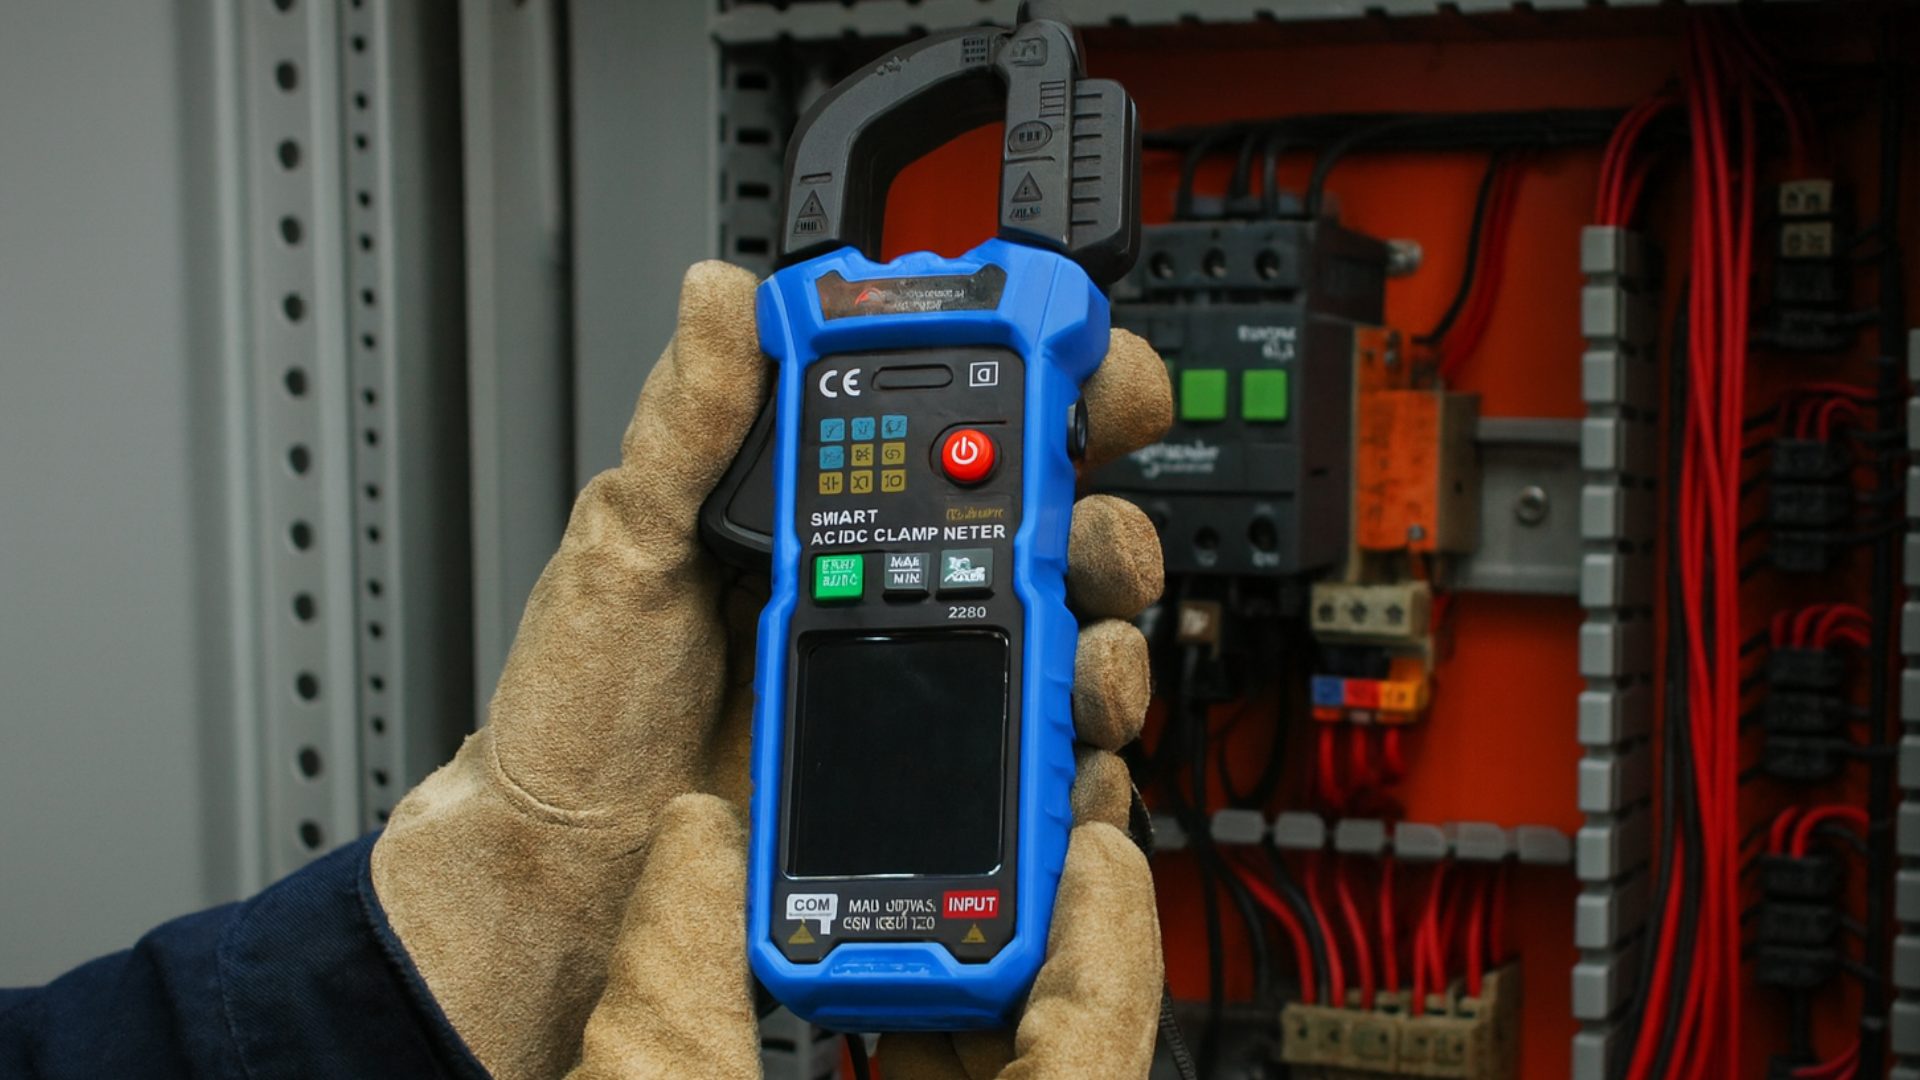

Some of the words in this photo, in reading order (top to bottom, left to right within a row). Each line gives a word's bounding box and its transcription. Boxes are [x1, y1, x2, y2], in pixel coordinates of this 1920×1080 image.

[819, 368, 862, 398] CE
[874, 527, 939, 542] CLAMP
[943, 524, 1006, 541] NETER
[948, 606, 987, 619] 2280
[794, 898, 830, 911] COM
[948, 897, 997, 912] INPUT
